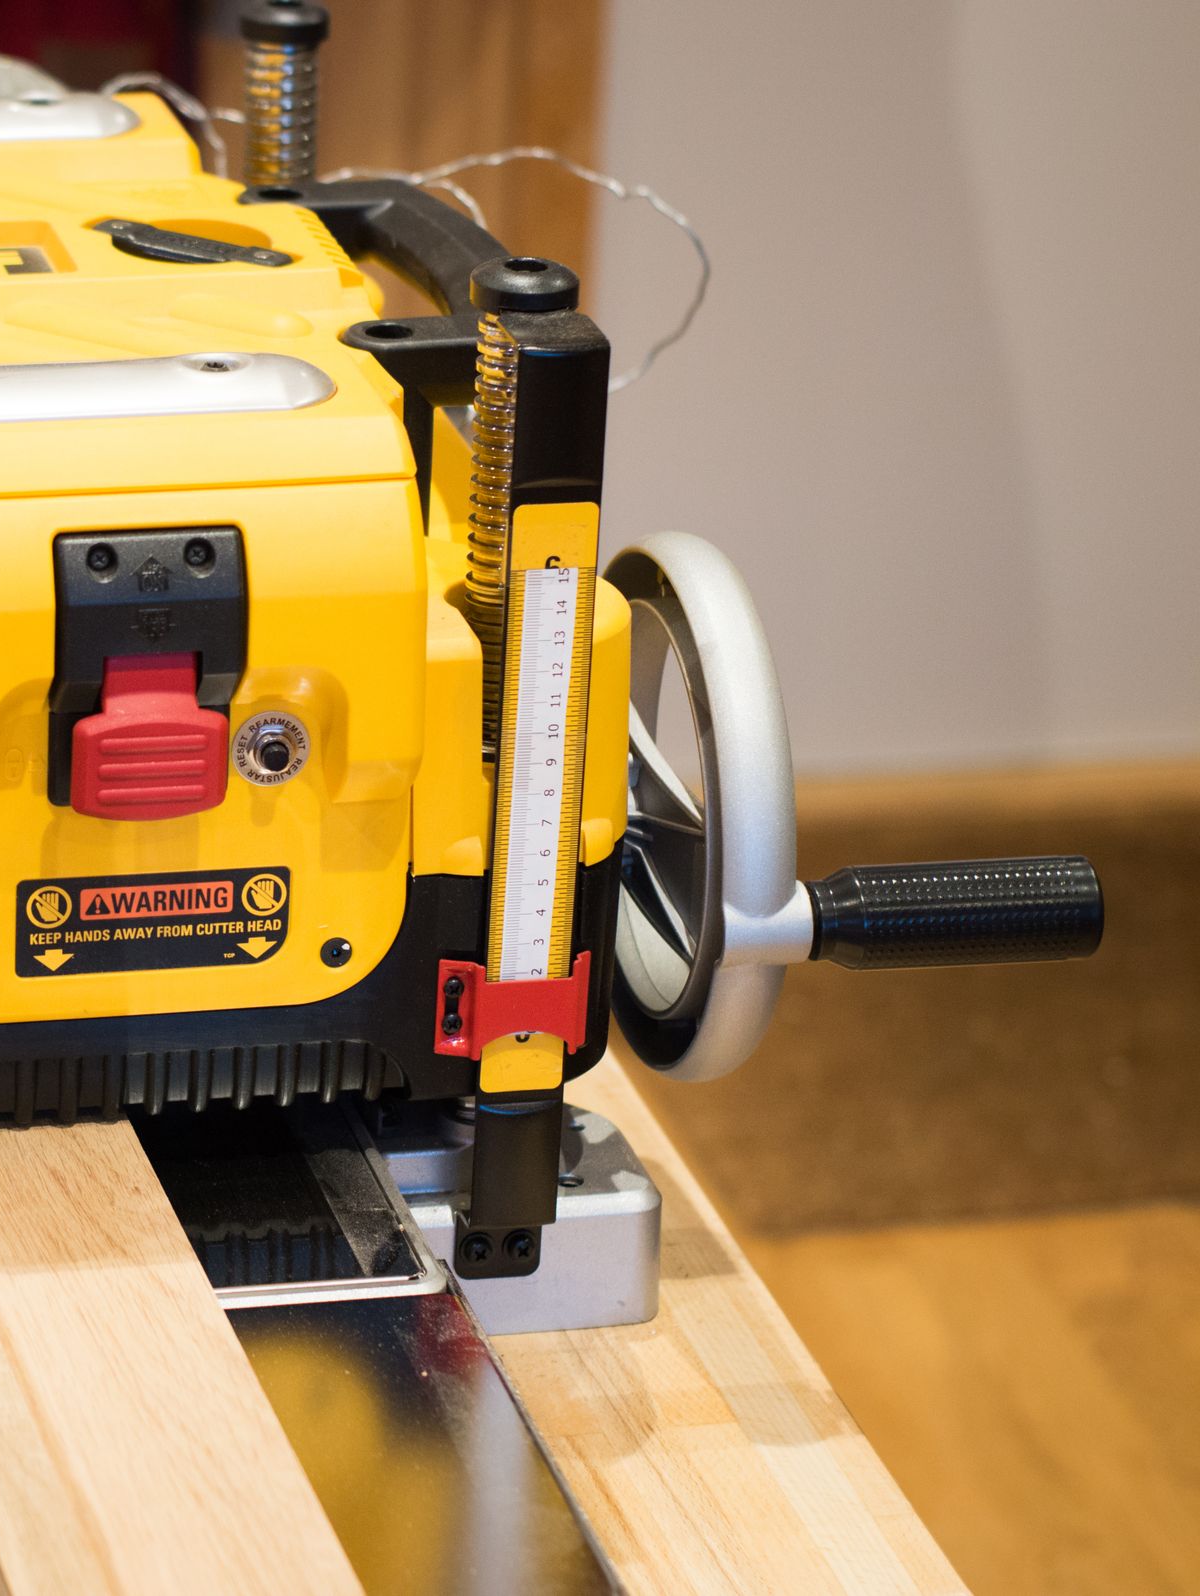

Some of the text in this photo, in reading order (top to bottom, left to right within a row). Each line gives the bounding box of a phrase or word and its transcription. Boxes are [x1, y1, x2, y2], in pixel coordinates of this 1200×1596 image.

[558, 567, 570, 584] 15
[556, 599, 567, 615] 14
[554, 630, 566, 646] 13
[552, 661, 564, 678] 12
[550, 692, 561, 708] 11
[248, 717, 306, 750] REARMEMENT
[548, 723, 560, 739] 10
[237, 735, 248, 768] RESET
[247, 757, 303, 783] REAJUSTAR
[545, 758, 557, 767] 9
[543, 788, 556, 797] 8
[541, 818, 553, 827] 7
[539, 848, 551, 857] 6
[537, 878, 549, 886] 5
[111, 886, 229, 914] WARNING
[535, 908, 547, 917] 4
[29, 918, 282, 946] KEEP HANDS AWAY FROM CUTTER HEAD
[533, 937, 545, 946] 3
[531, 967, 543, 976] 2
